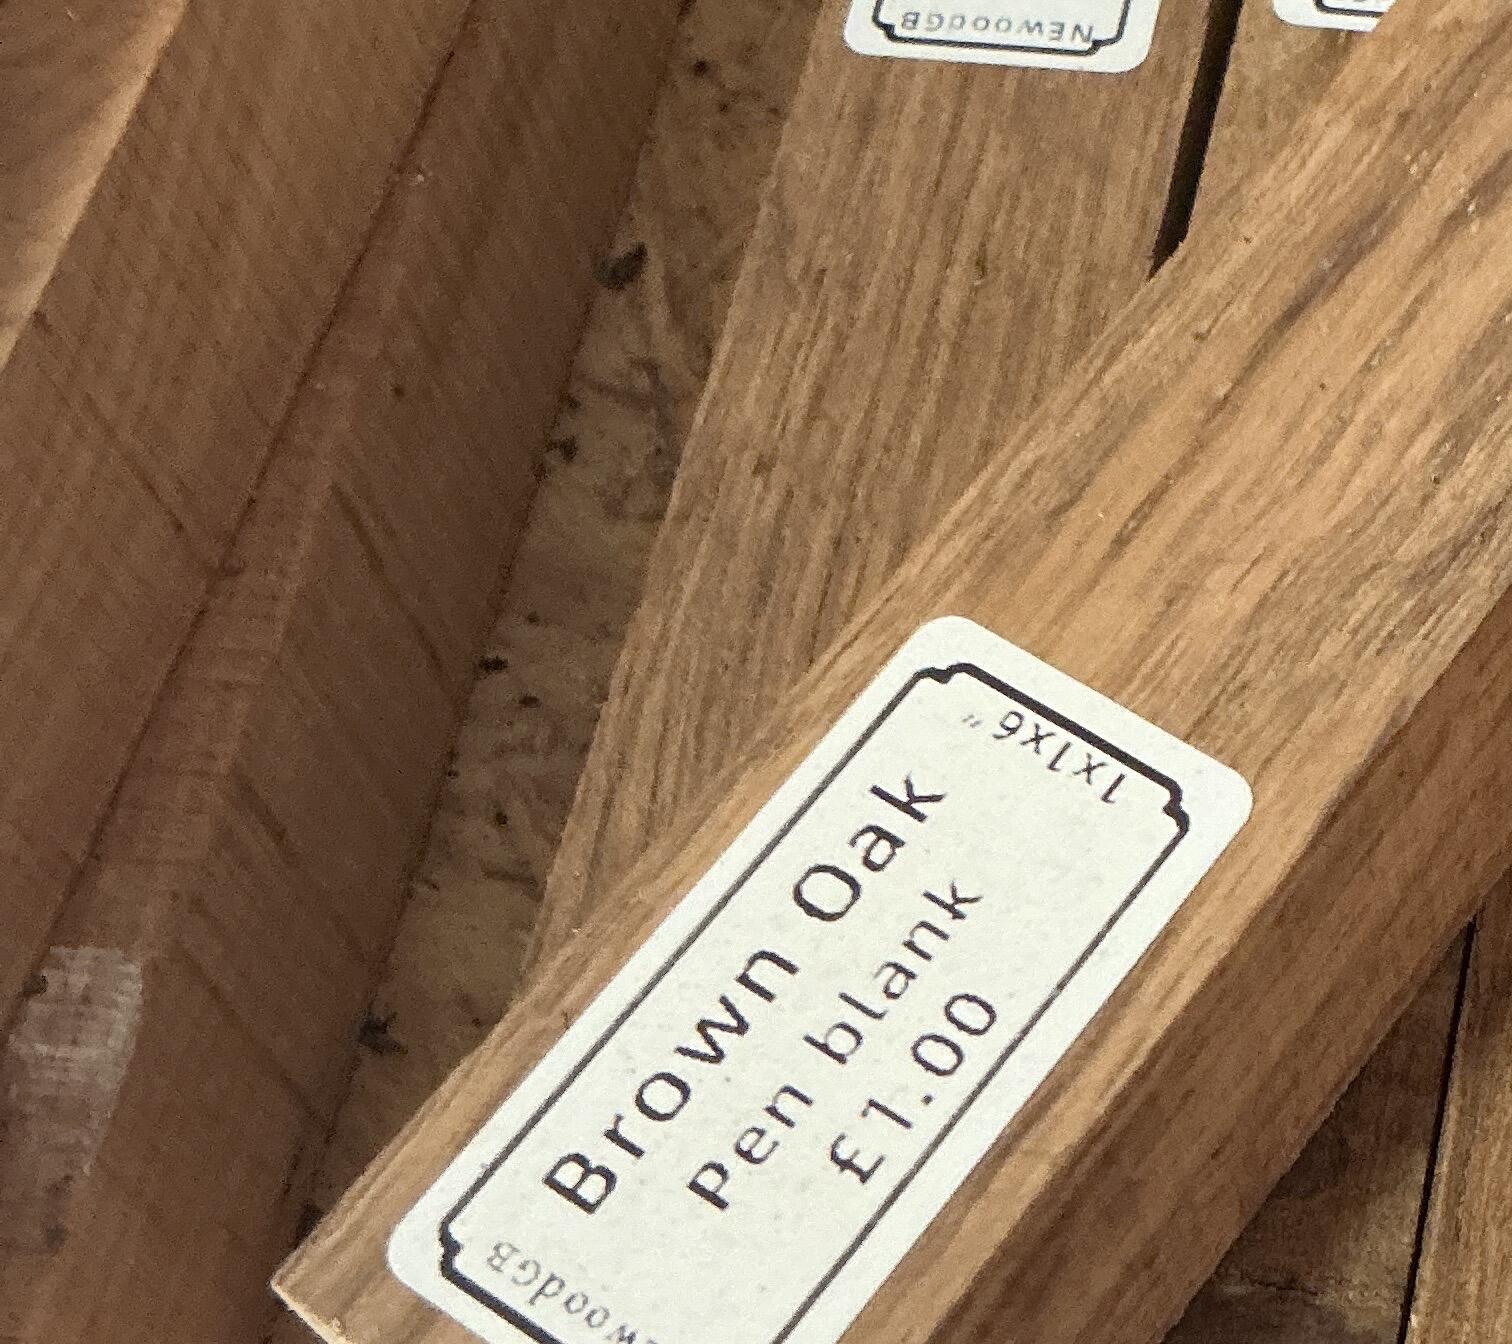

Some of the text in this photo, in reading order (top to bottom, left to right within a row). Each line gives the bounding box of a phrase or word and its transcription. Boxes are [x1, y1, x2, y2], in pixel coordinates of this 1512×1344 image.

[543, 771, 946, 1216] Brown Oak
[688, 880, 983, 1211] Pen blank
[830, 992, 997, 1186] £1.00
